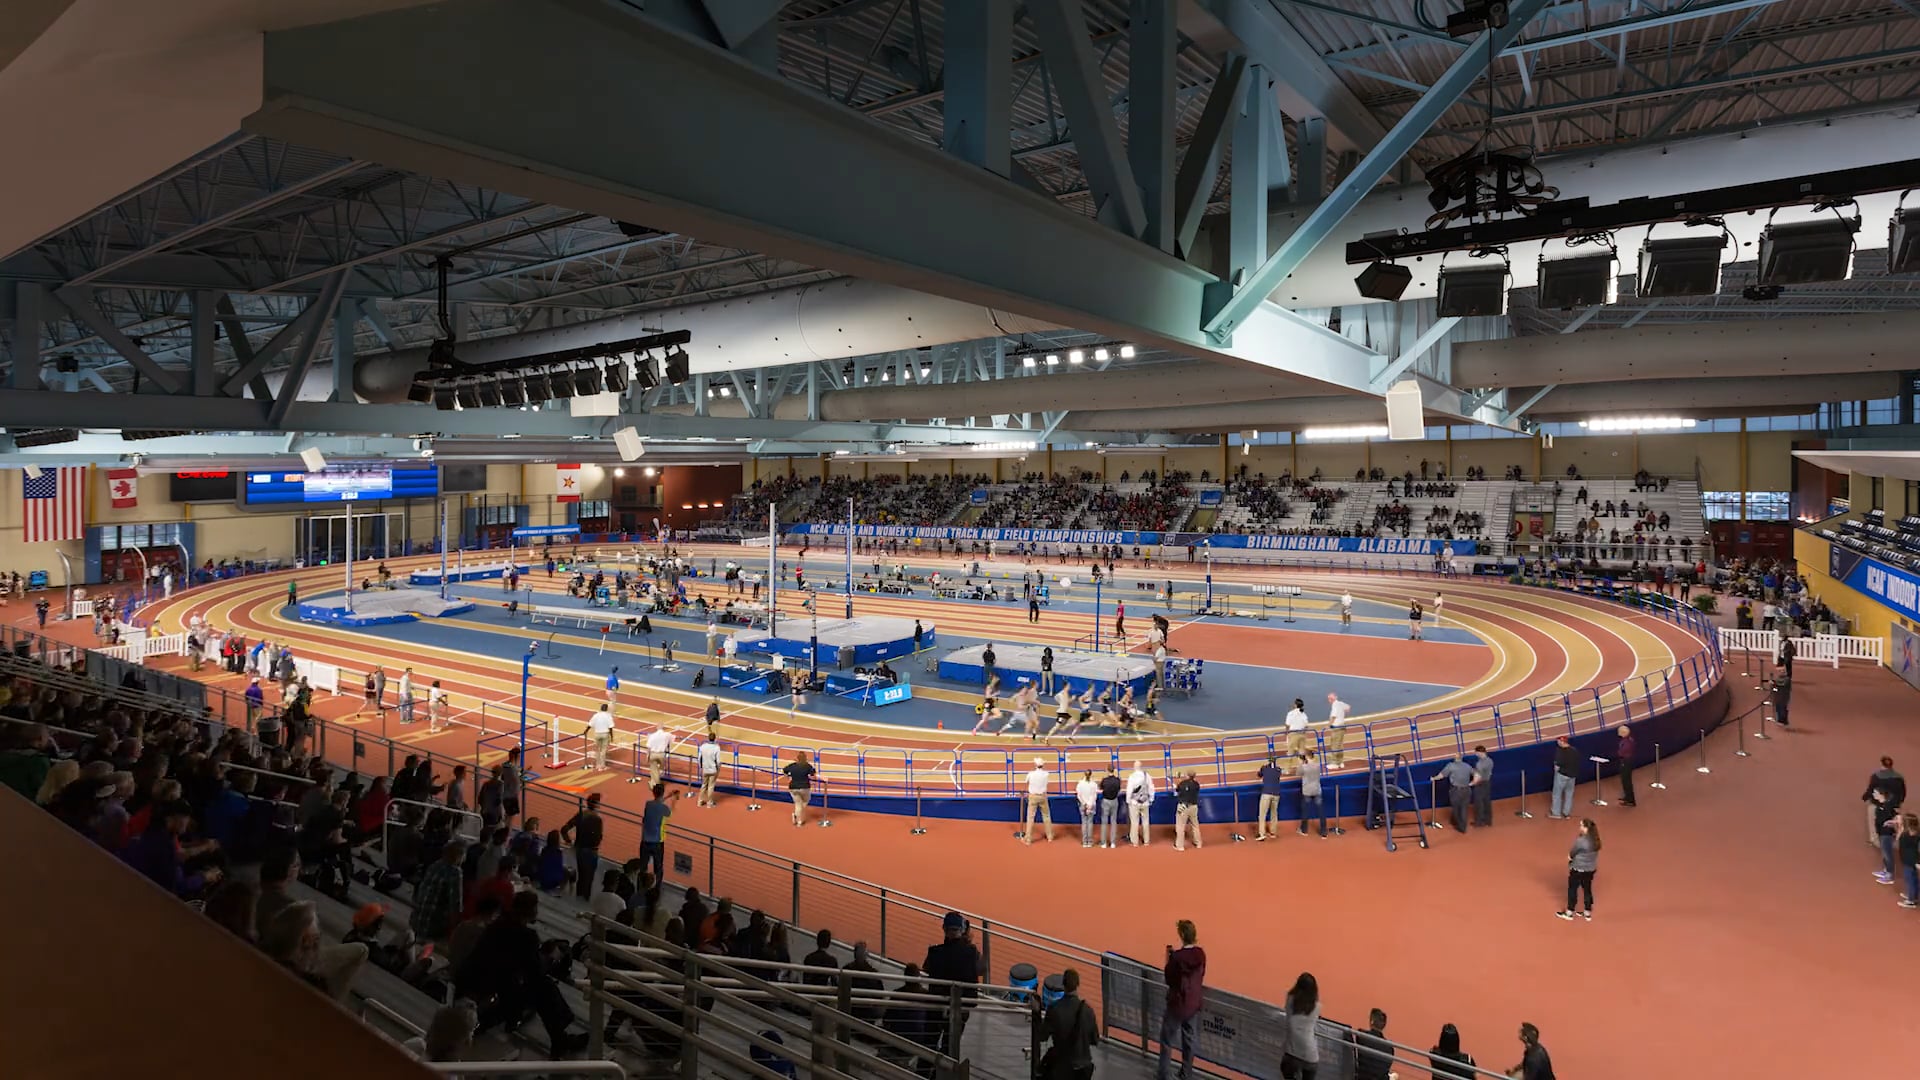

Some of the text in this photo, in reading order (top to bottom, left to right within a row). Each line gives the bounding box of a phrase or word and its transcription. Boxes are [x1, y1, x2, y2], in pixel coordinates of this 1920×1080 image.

[858, 525, 874, 536] AND
[876, 525, 914, 537] WOMEN'S
[915, 527, 948, 538] INDOOR
[950, 527, 979, 539] TRACK
[980, 528, 1000, 540] AND
[1003, 529, 1030, 540] FIELD
[1032, 530, 1123, 544] CHAMPIONSHIPS
[1246, 535, 1431, 554] BIRMINGHAM, ALABAMA
[1887, 573, 1917, 612] INDOOR
